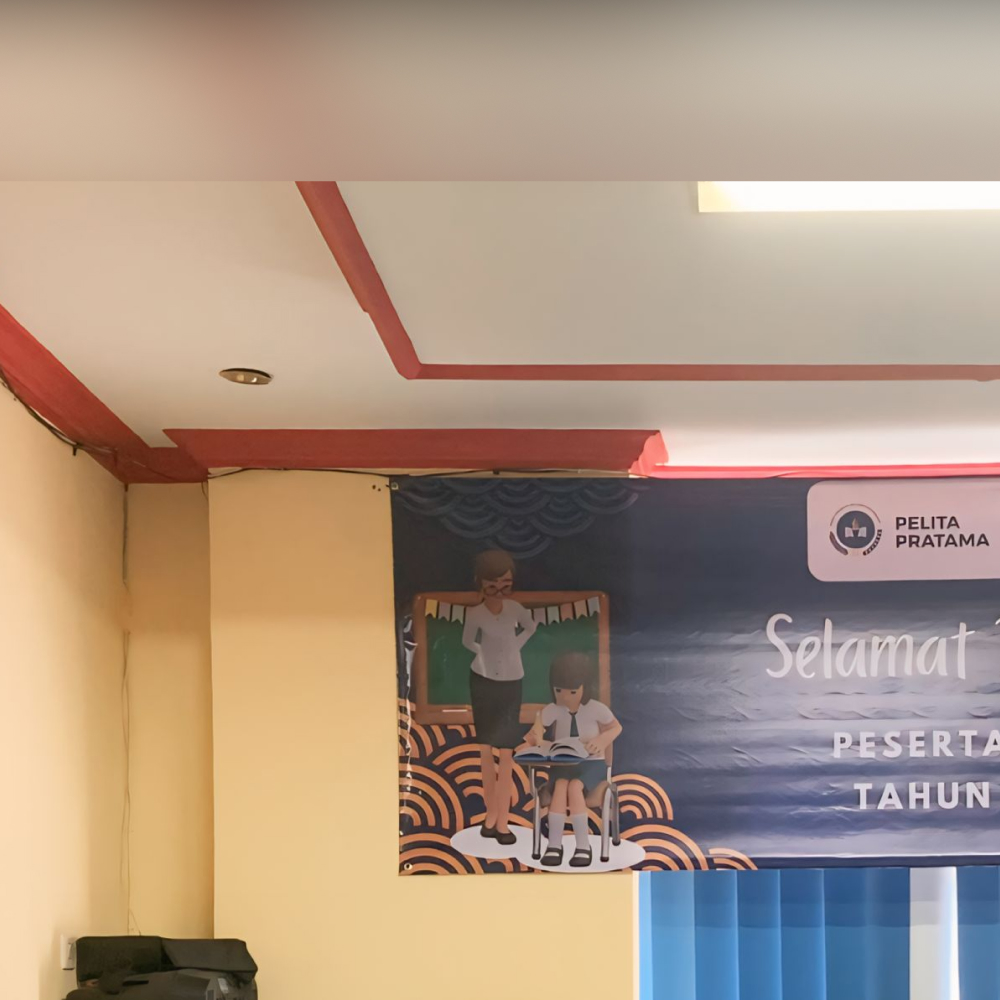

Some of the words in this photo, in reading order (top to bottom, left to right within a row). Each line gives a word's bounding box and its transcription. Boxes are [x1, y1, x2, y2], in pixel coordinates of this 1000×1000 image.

[895, 515, 961, 531] PELITA
[895, 533, 990, 549] PRATAMA
[765, 613, 976, 680] Selamat
[853, 782, 991, 810] TAHUN
